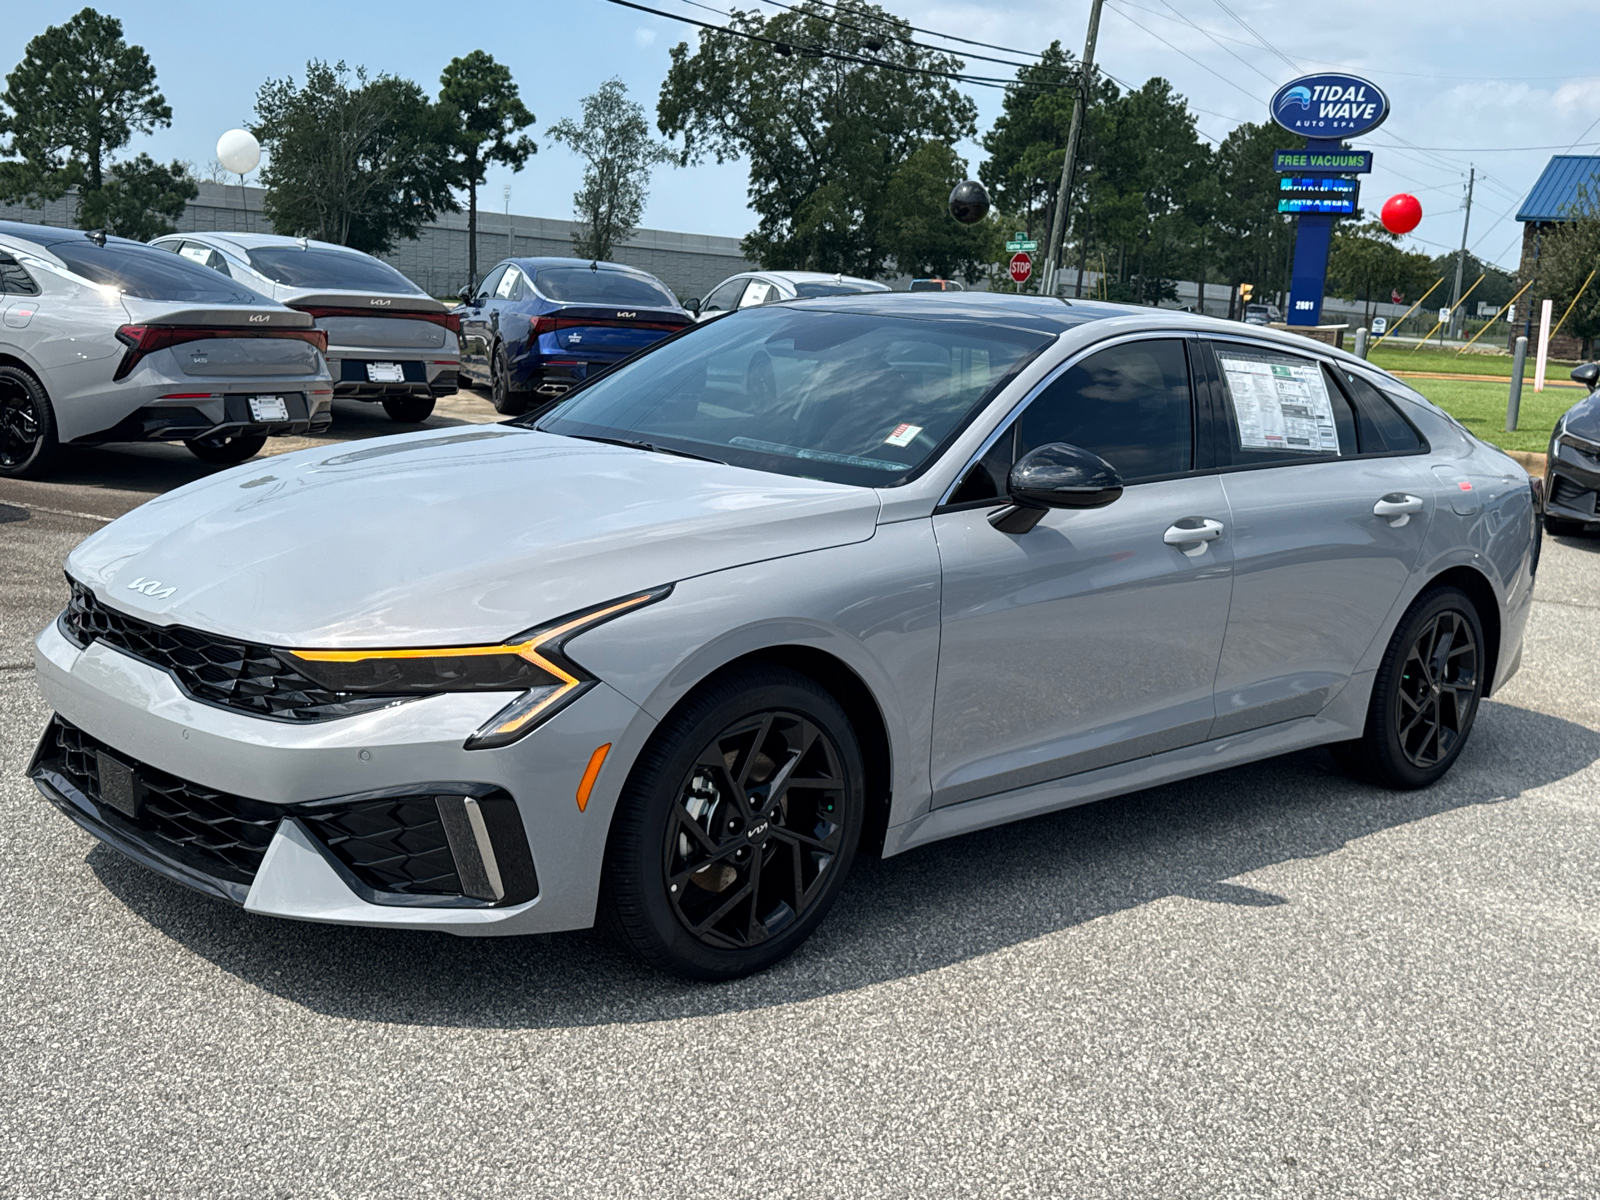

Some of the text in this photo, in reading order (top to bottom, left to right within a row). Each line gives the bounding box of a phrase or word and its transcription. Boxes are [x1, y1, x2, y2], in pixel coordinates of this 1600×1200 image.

[1312, 86, 1366, 102] TIDAL
[1319, 103, 1377, 119] WAVE
[1277, 154, 1365, 167] FREE VACUUMS
[1011, 262, 1030, 274] STOP
[249, 314, 271, 323] KIA
[127, 577, 177, 599] KIA
